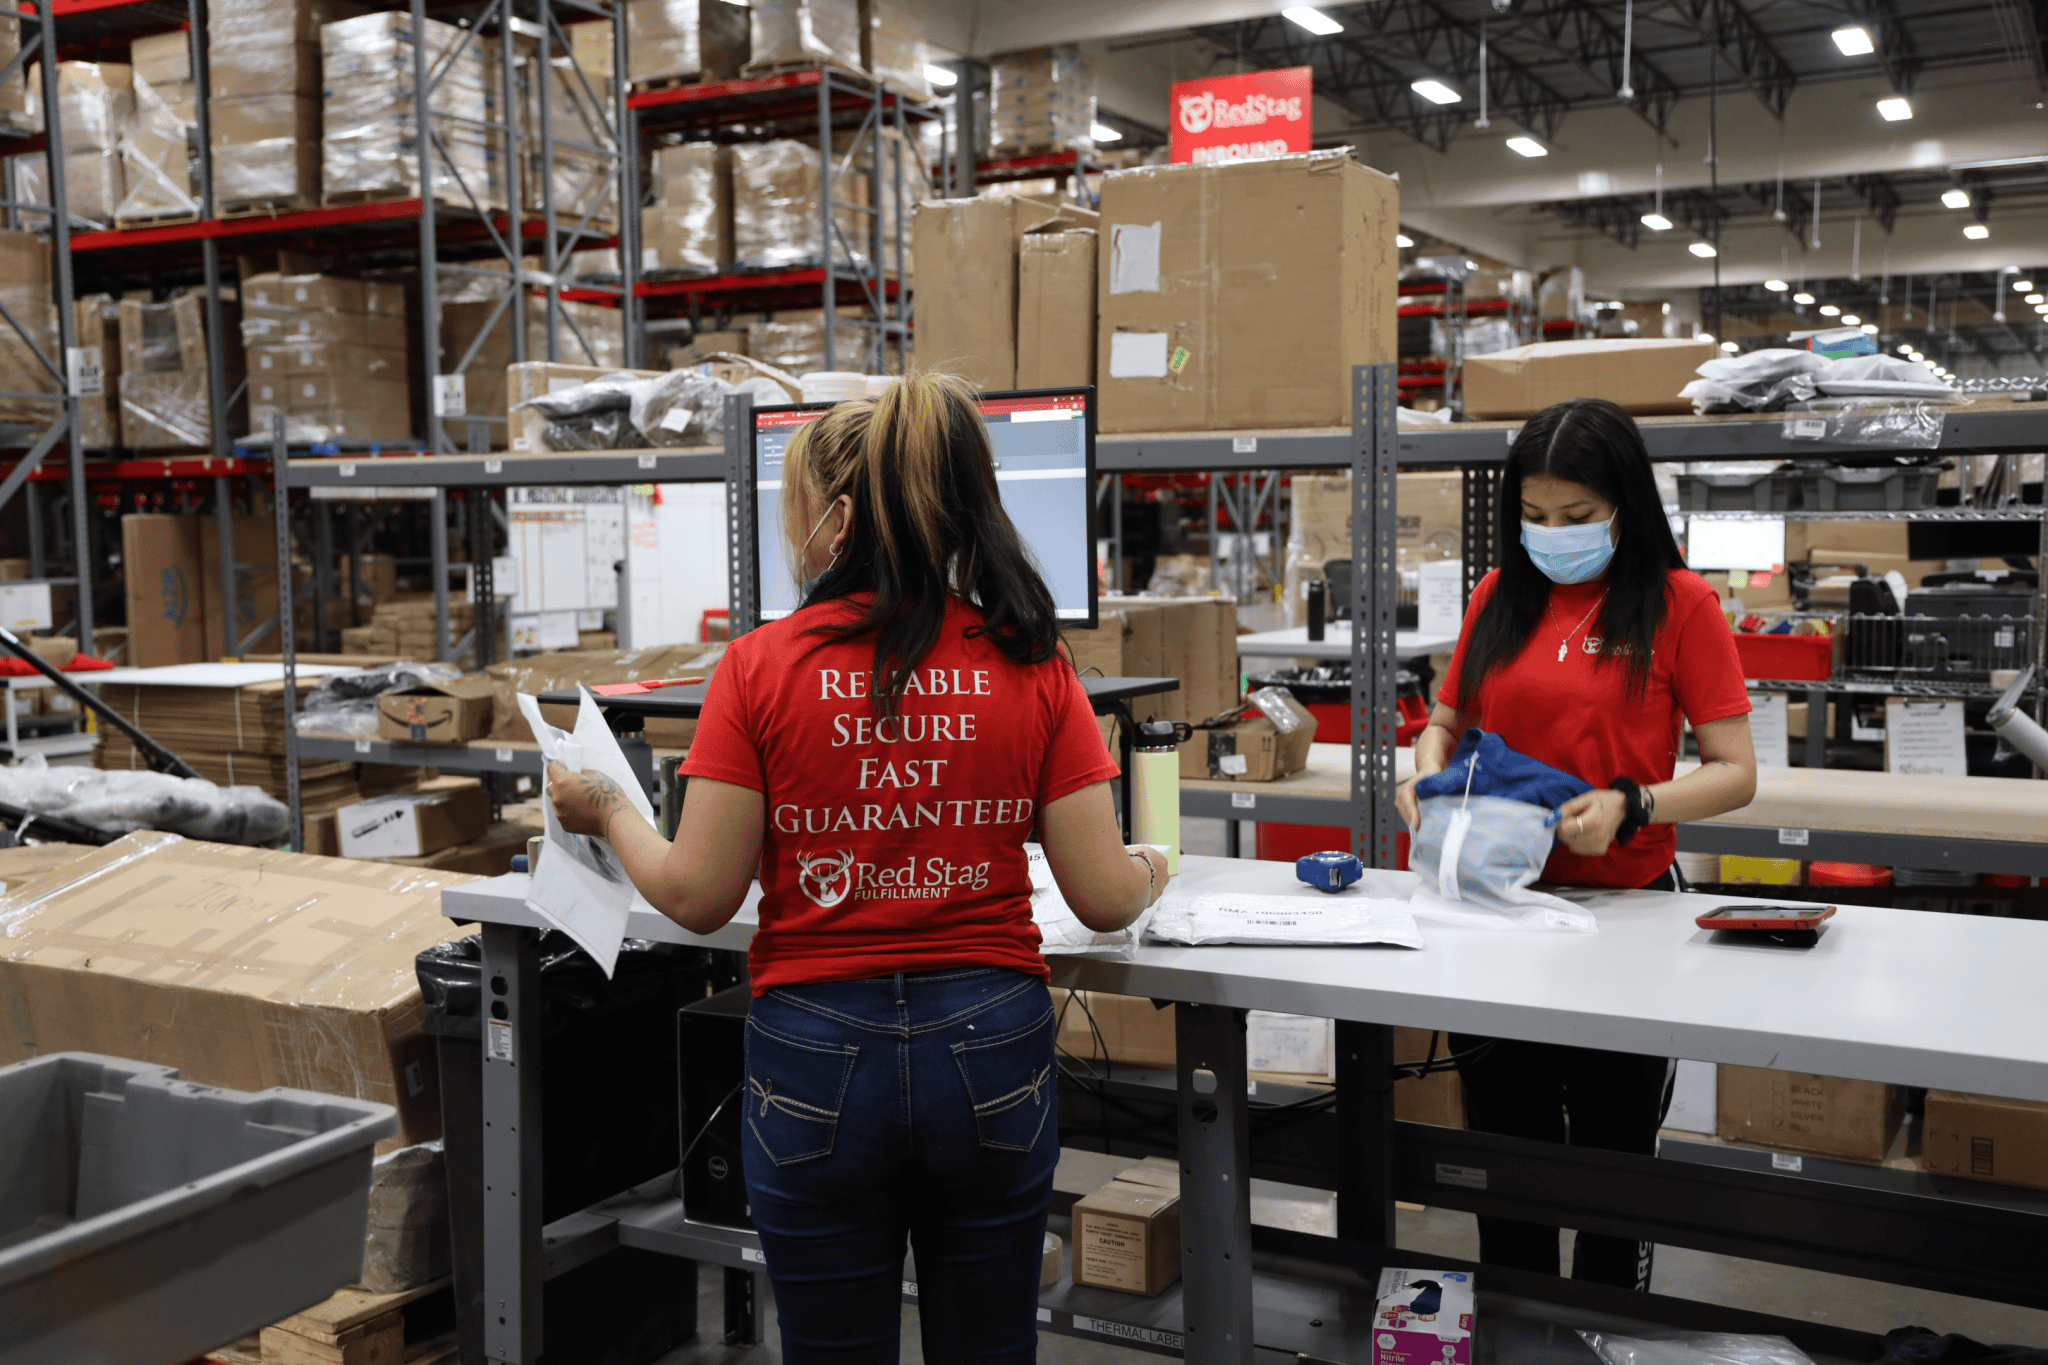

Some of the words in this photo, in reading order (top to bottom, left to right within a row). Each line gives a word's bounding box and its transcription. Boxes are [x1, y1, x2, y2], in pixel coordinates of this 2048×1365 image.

[818, 668, 991, 700] REABLE
[831, 713, 976, 747] SECURE
[856, 757, 948, 790] FAST
[774, 798, 1034, 834] GUARANTEED
[855, 856, 917, 890] Red
[924, 857, 991, 891] Stag
[854, 886, 950, 901] FULFILLMENT
[1099, 1238, 1126, 1247] CAUTION
[1089, 1318, 1147, 1341] THERMAL
[1380, 1353, 1405, 1363] Nitrile
